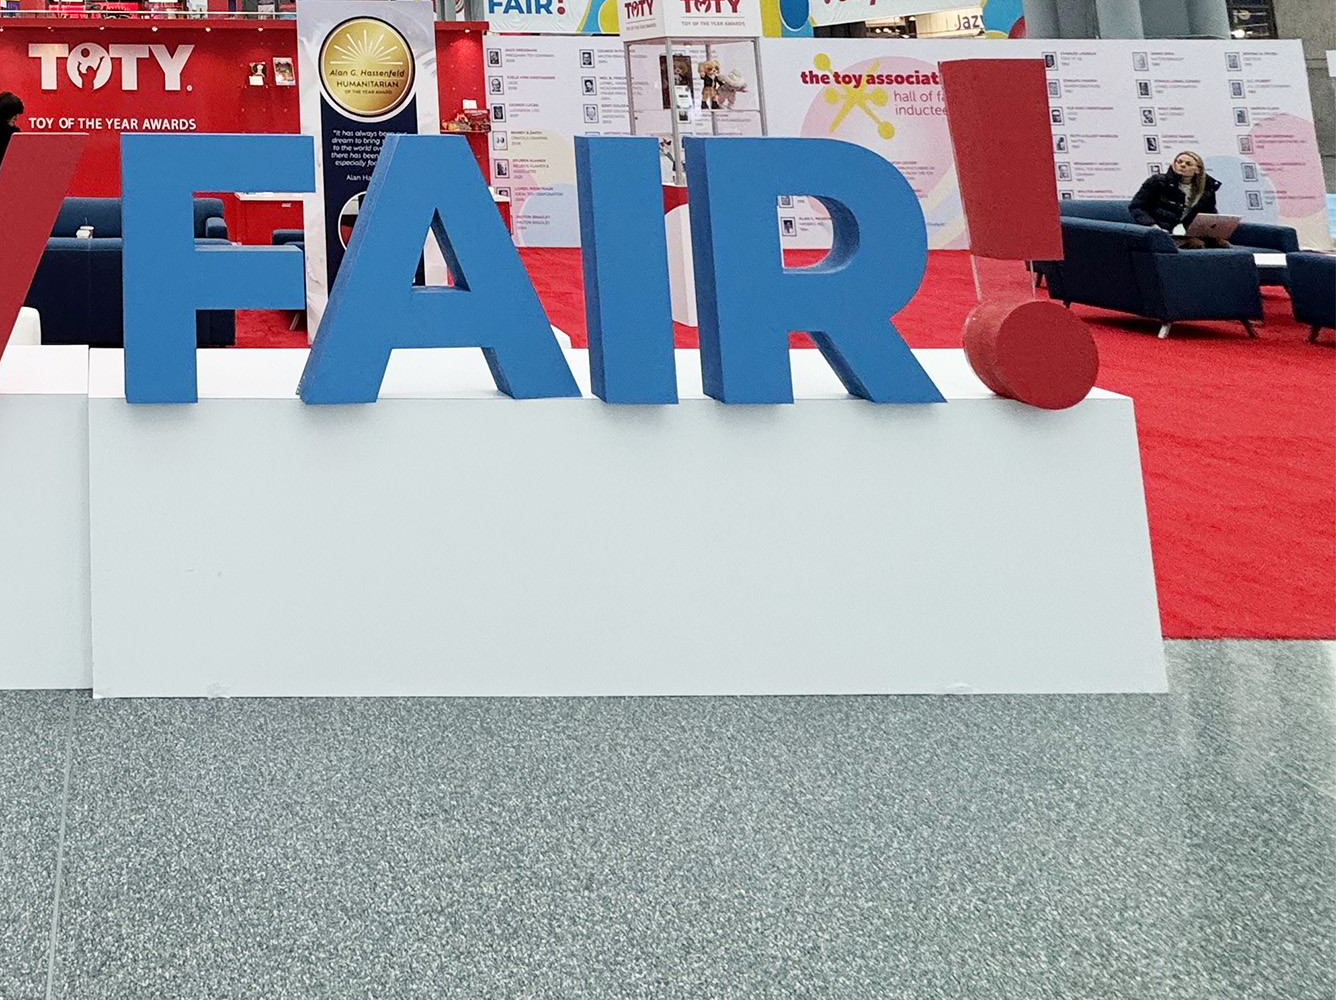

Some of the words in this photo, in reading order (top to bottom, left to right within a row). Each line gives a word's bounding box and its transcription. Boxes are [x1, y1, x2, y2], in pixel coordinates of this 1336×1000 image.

[956, 14, 980, 31] Jaz
[330, 69, 348, 77] Alan
[361, 69, 405, 78] Hassenfeld
[336, 80, 399, 88] HUMANITARIAN
[800, 71, 831, 85] the
[832, 72, 863, 89] toy
[865, 71, 940, 86] associat
[893, 90, 916, 103] hall
[920, 90, 934, 102] of
[895, 104, 949, 117] inductee
[28, 117, 54, 129] TOY
[58, 117, 75, 129] OF
[77, 117, 103, 129] THE
[105, 118, 139, 130] YEAR
[141, 118, 197, 130] AWARDS
[342, 129, 354, 137] has
[355, 130, 378, 138] always
[363, 137, 381, 146] bring
[341, 144, 352, 152] the
[353, 144, 372, 152] world
[335, 159, 366, 168] especially
[346, 173, 361, 181] Alan
